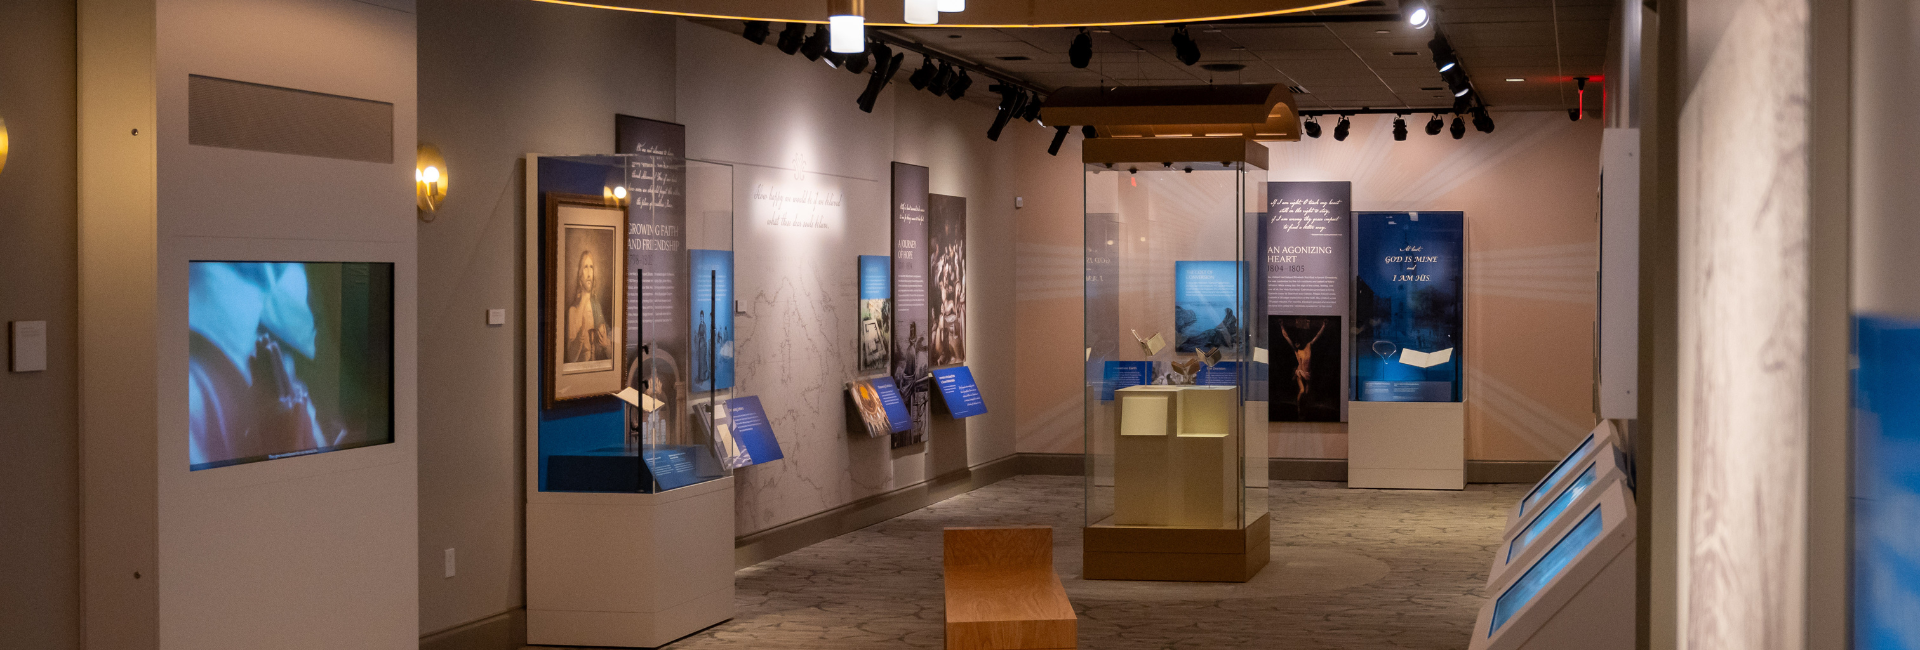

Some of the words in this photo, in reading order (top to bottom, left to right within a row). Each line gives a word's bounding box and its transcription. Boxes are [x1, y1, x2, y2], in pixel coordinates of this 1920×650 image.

[754, 183, 768, 200] How
[769, 186, 783, 210] happy
[793, 190, 808, 204] would
[766, 211, 781, 226] what
[628, 222, 660, 236] GROWING
[660, 224, 679, 237] FAITH
[628, 238, 642, 250] AND
[642, 239, 680, 252] FRIENDSHIP
[898, 240, 902, 248] A
[901, 240, 917, 250] JOURNEY
[898, 251, 903, 259] OF
[903, 251, 913, 259] HOPE
[1267, 246, 1281, 254] AN
[1281, 246, 1332, 255] AGONIZING
[1267, 255, 1298, 263] HEART
[1384, 256, 1404, 264] GOD
